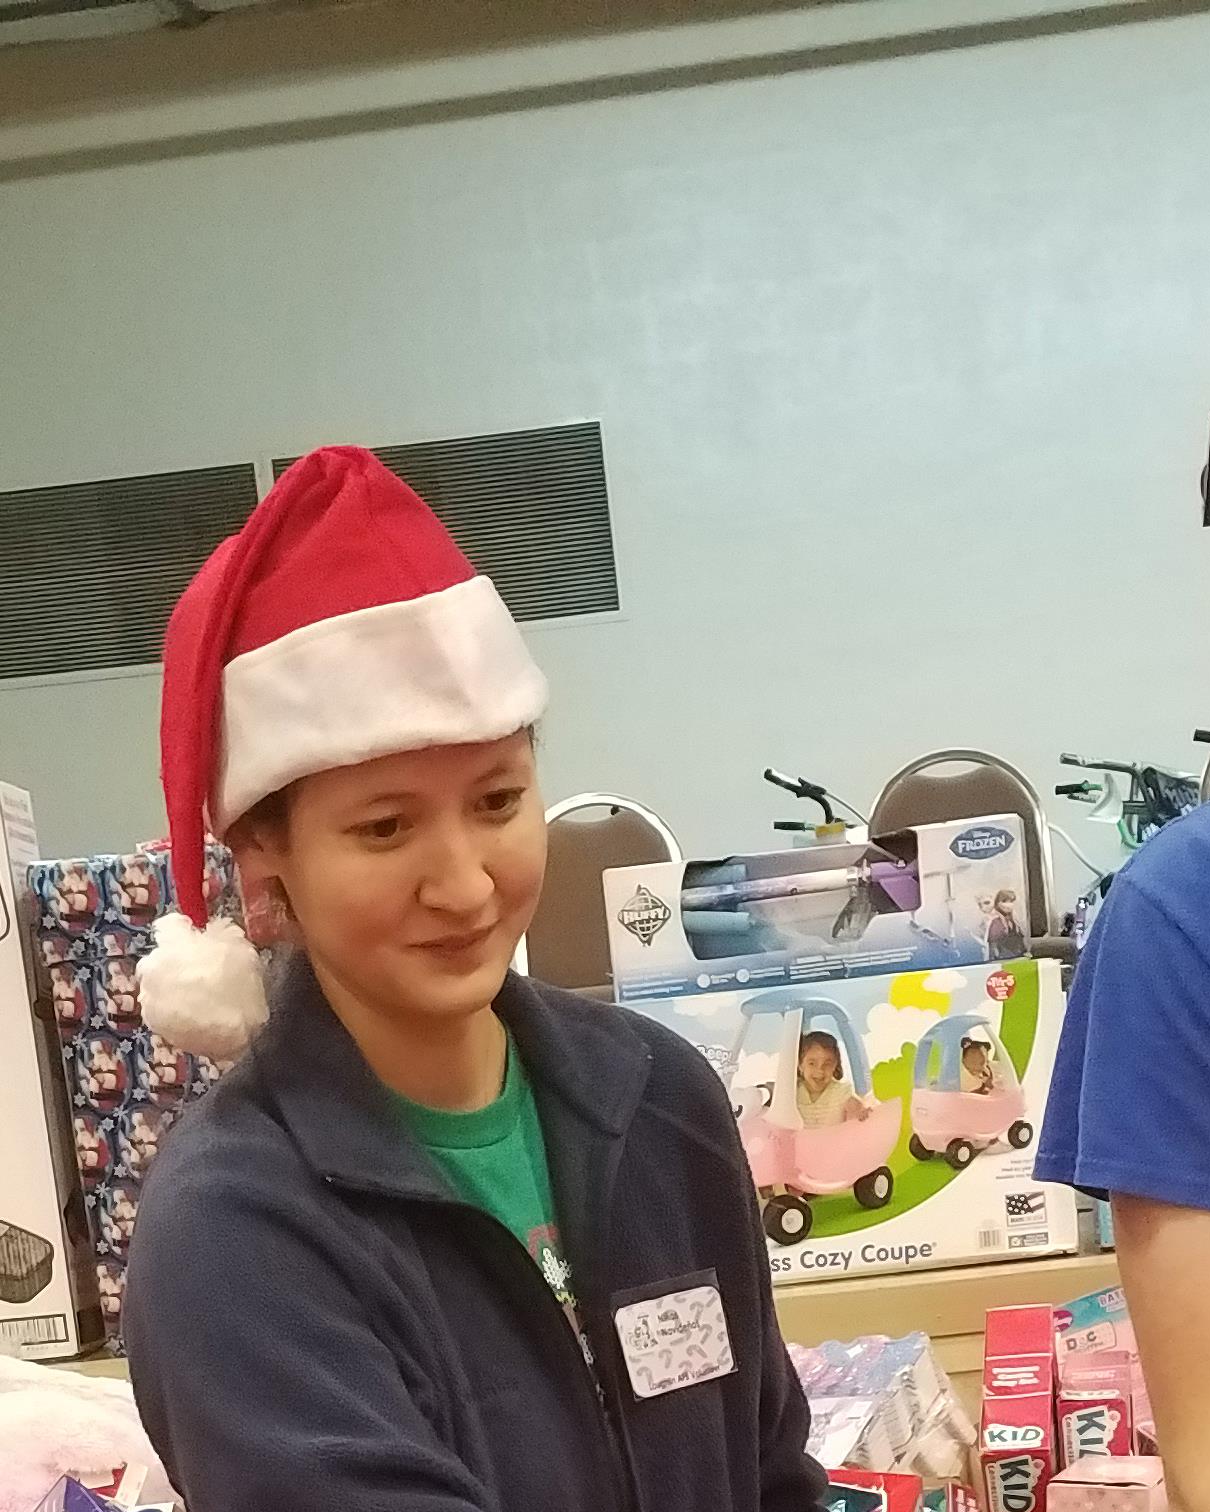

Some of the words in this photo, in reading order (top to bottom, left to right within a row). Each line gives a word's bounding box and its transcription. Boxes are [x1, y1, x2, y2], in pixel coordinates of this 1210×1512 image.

[958, 837, 1006, 852] FROZEN
[624, 905, 667, 924] HUFFY
[800, 1250, 853, 1271] Cozy
[861, 1242, 934, 1265] Coupe
[988, 1427, 1041, 1443] KID
[999, 1458, 1033, 1512] KID
